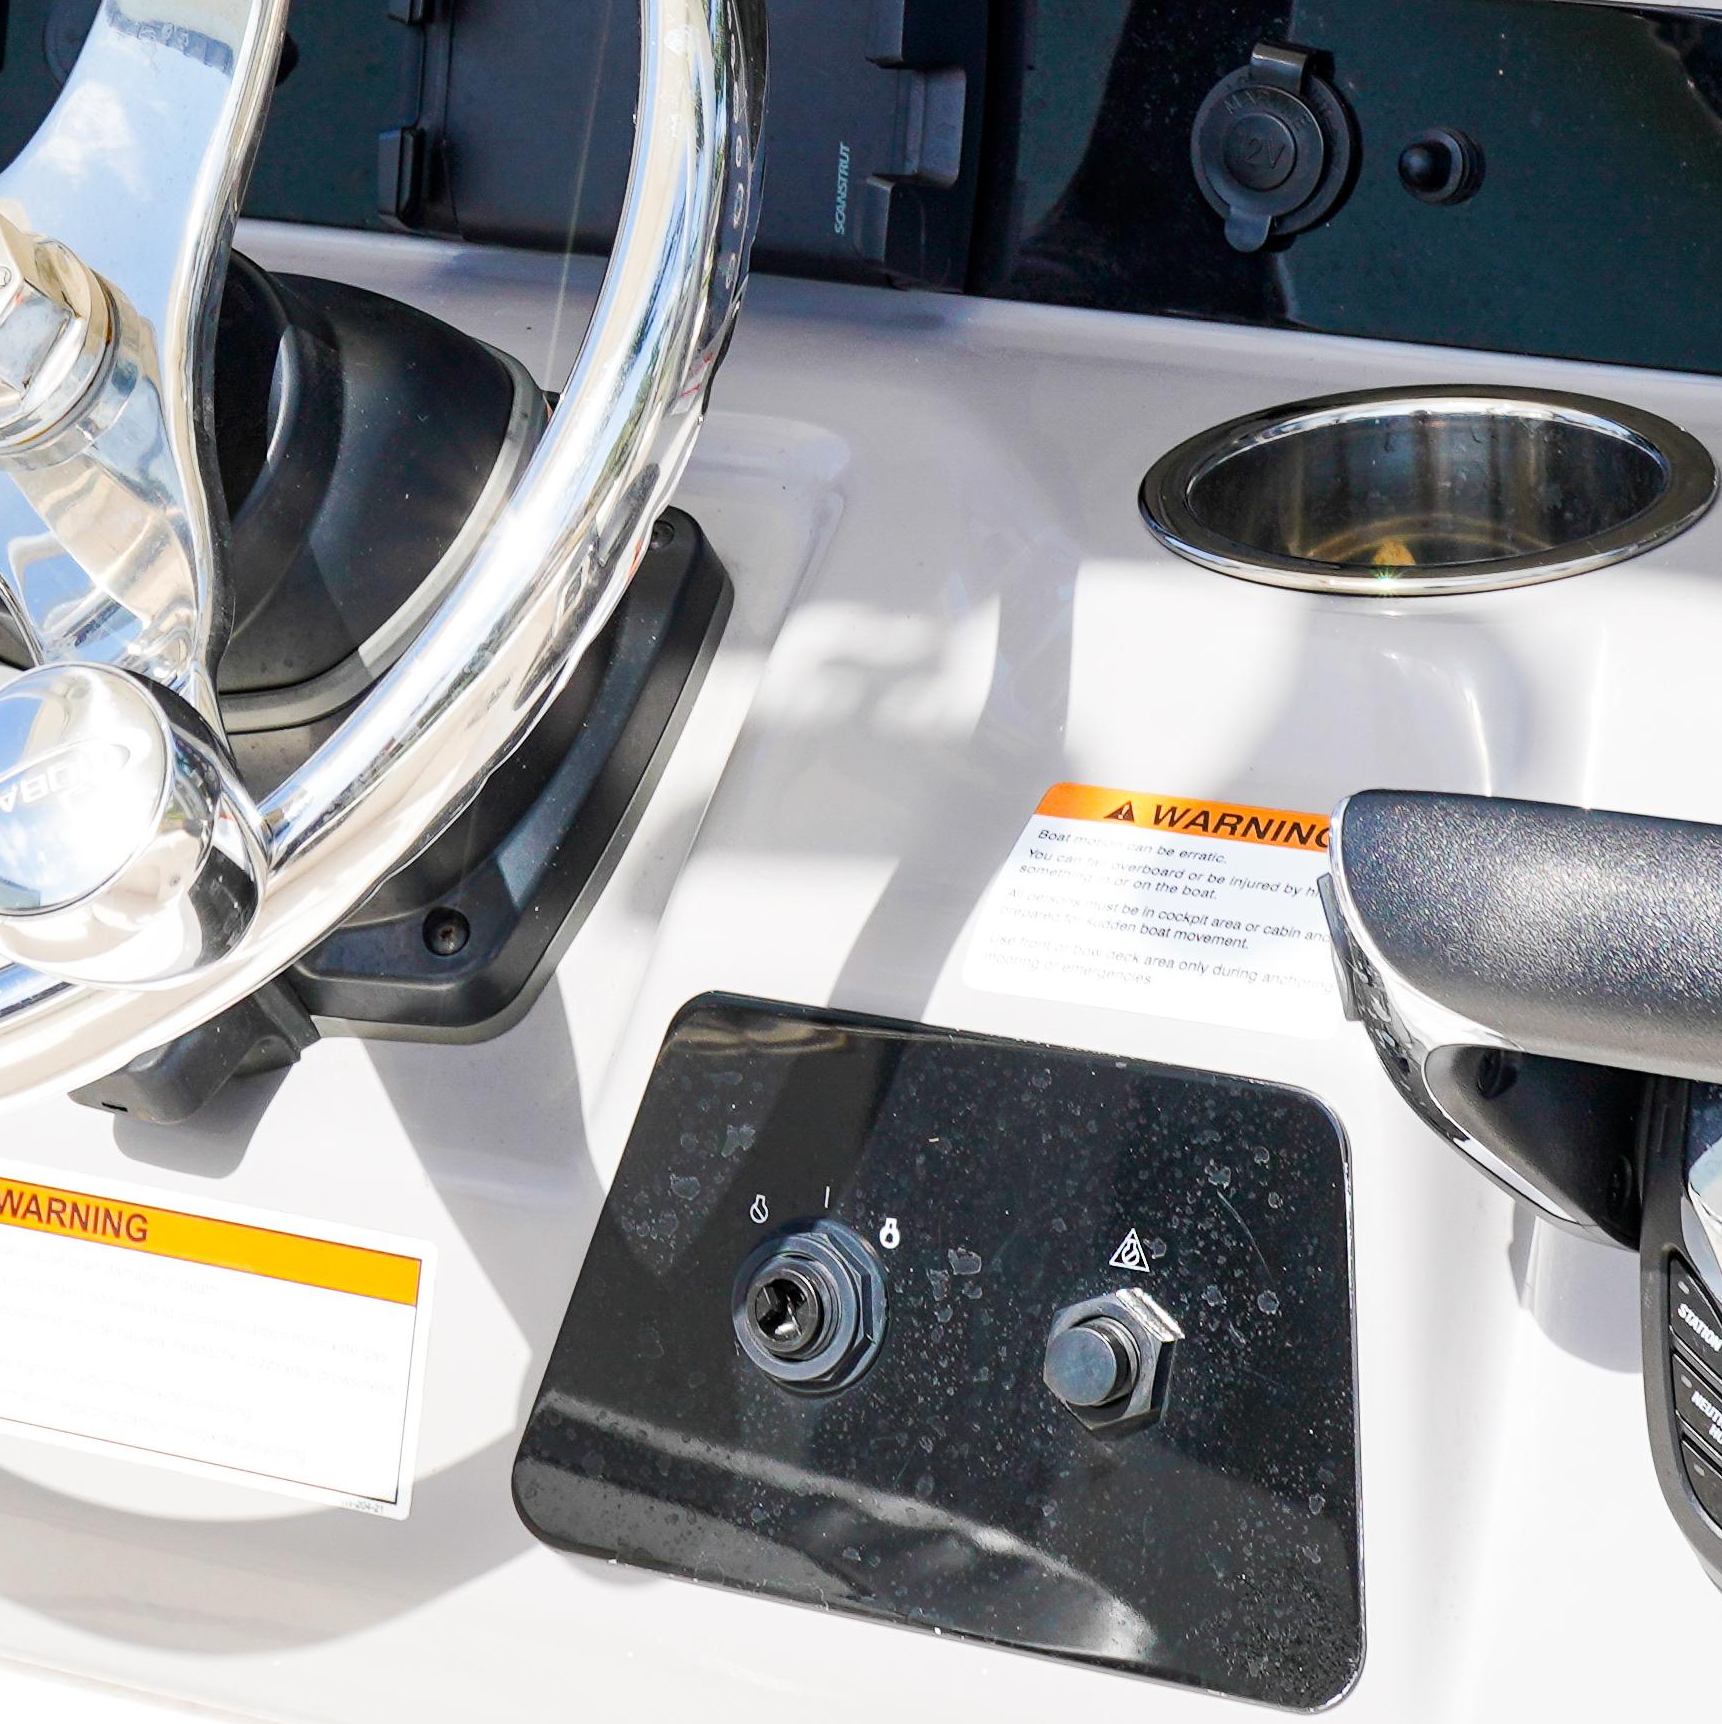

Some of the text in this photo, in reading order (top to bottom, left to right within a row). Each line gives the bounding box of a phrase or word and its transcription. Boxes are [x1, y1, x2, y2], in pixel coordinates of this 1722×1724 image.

[834, 139, 851, 236] SCANSTRUT
[1038, 829, 1073, 842] Boat
[1128, 842, 1154, 853] can
[1157, 844, 1177, 855] be
[1180, 846, 1231, 862] erratic.
[1027, 849, 1055, 860] You
[1111, 860, 1186, 878] overboard
[1189, 872, 1205, 880] or
[1209, 872, 1227, 883] be
[1230, 875, 1282, 893] injured
[1284, 883, 1303, 897] by
[1133, 881, 1153, 890] on
[1155, 881, 1180, 893] the
[1183, 885, 1220, 899] boat.
[1122, 903, 1142, 914] be
[1143, 905, 1157, 916] in
[1158, 908, 1211, 926] cockpit
[1212, 917, 1243, 929] area
[1246, 922, 1262, 932] or
[1263, 923, 1301, 939] cabin
[1140, 924, 1172, 937] boat
[1174, 928, 1252, 949] movement.
[1145, 956, 1176, 968] area
[1178, 959, 1208, 976] only
[1212, 964, 1259, 984] during
[1677, 1302, 1722, 1352] STATION
